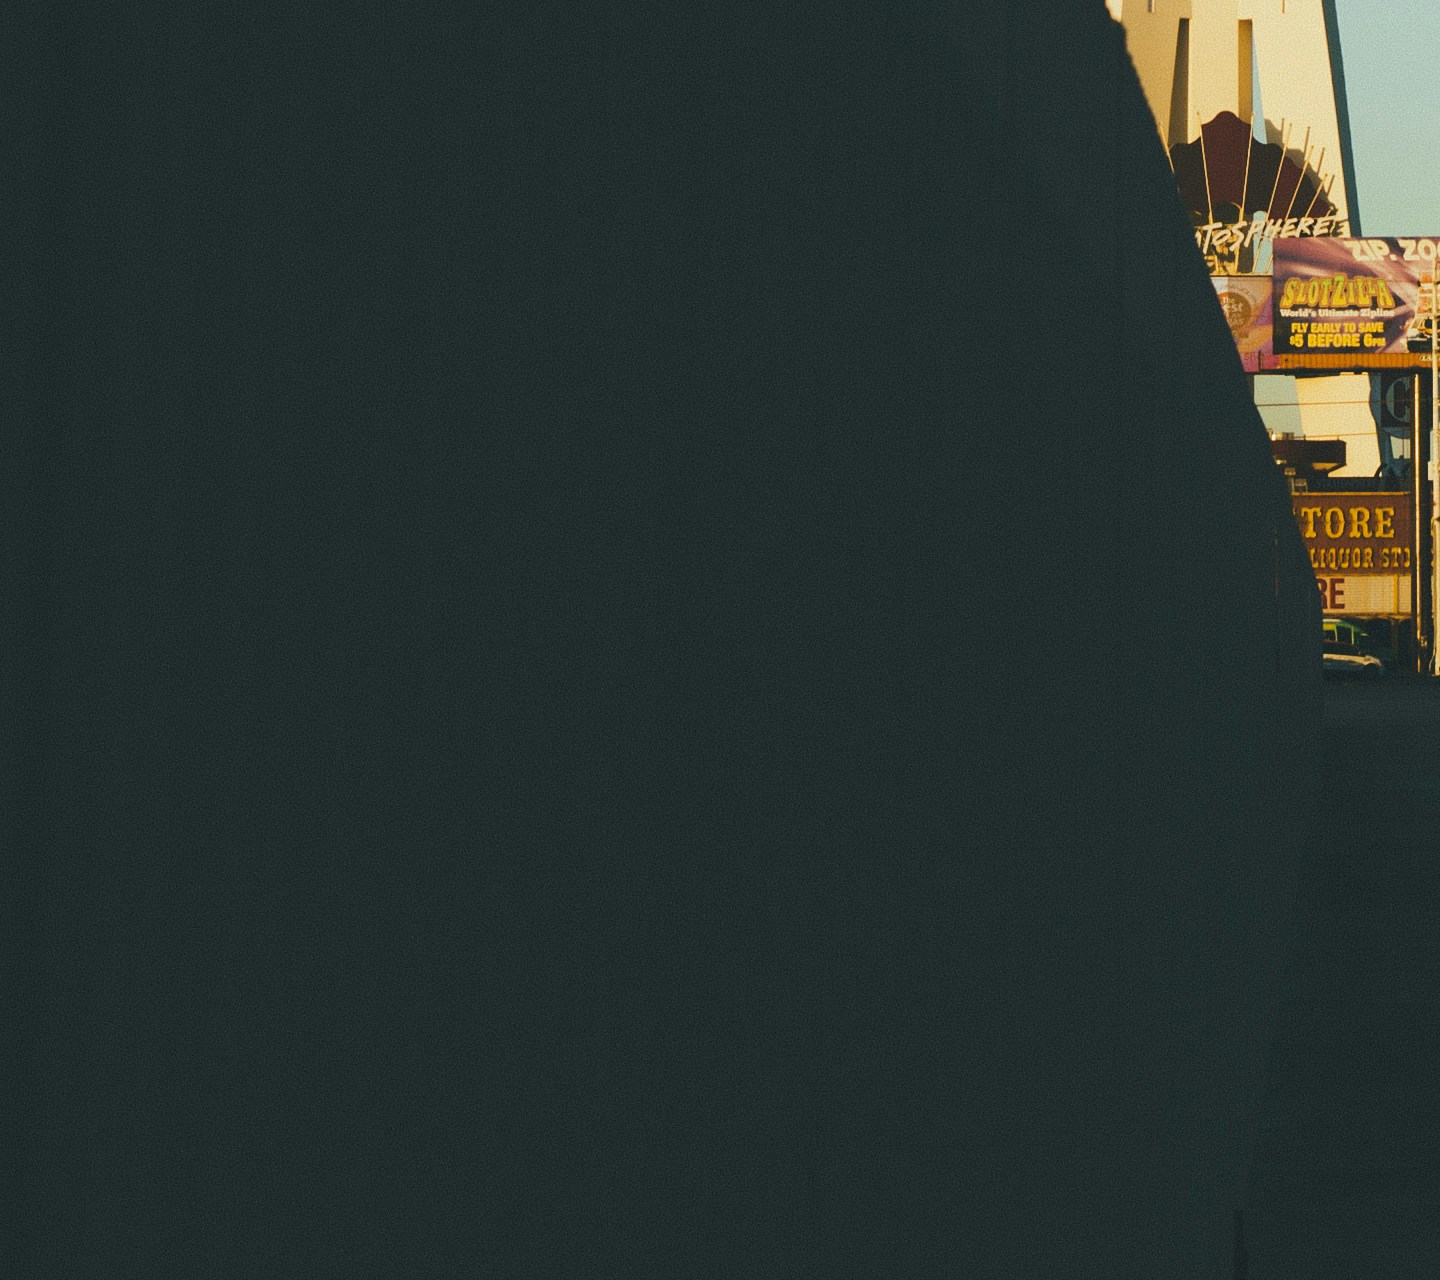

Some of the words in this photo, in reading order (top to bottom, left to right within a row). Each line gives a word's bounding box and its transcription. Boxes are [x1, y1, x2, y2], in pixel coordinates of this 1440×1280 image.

[1345, 240, 1397, 261] ZIP.
[1280, 308, 1317, 318] World's
[1318, 308, 1359, 318] Ultimate
[1360, 308, 1395, 319] Zipline
[1291, 322, 1308, 333] FLY
[1310, 322, 1342, 333] EARLY
[1344, 322, 1357, 333] TO
[1358, 322, 1385, 333] SAVE
[1289, 334, 1304, 348] $5
[1307, 333, 1360, 348] BEFORE
[1294, 506, 1396, 539] TORE
[1311, 547, 1374, 570] LIQUOR
[1316, 578, 1345, 610] RE
